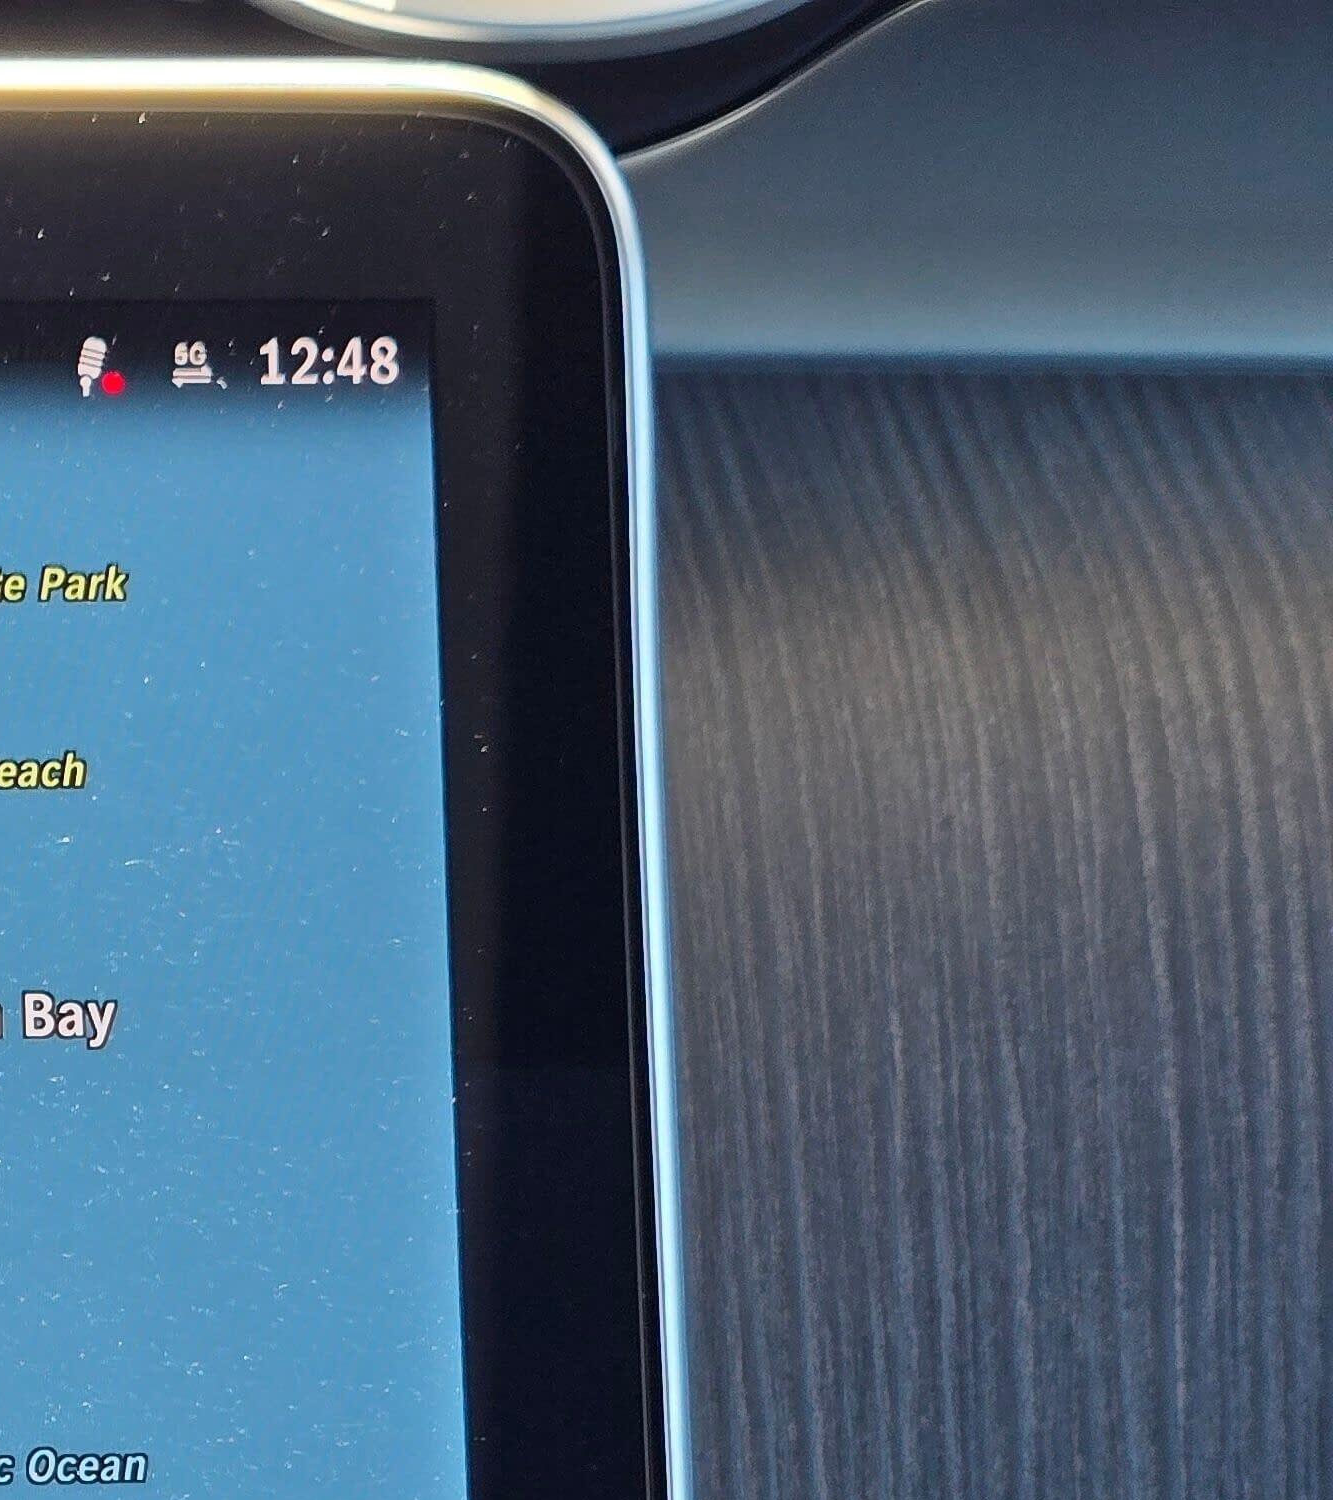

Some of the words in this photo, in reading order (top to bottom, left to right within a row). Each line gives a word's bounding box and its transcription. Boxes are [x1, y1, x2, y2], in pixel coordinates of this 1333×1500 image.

[259, 336, 400, 385] 12:48
[40, 566, 128, 601] Park
[23, 992, 117, 1047] Bay
[27, 1448, 148, 1484] Ocean
